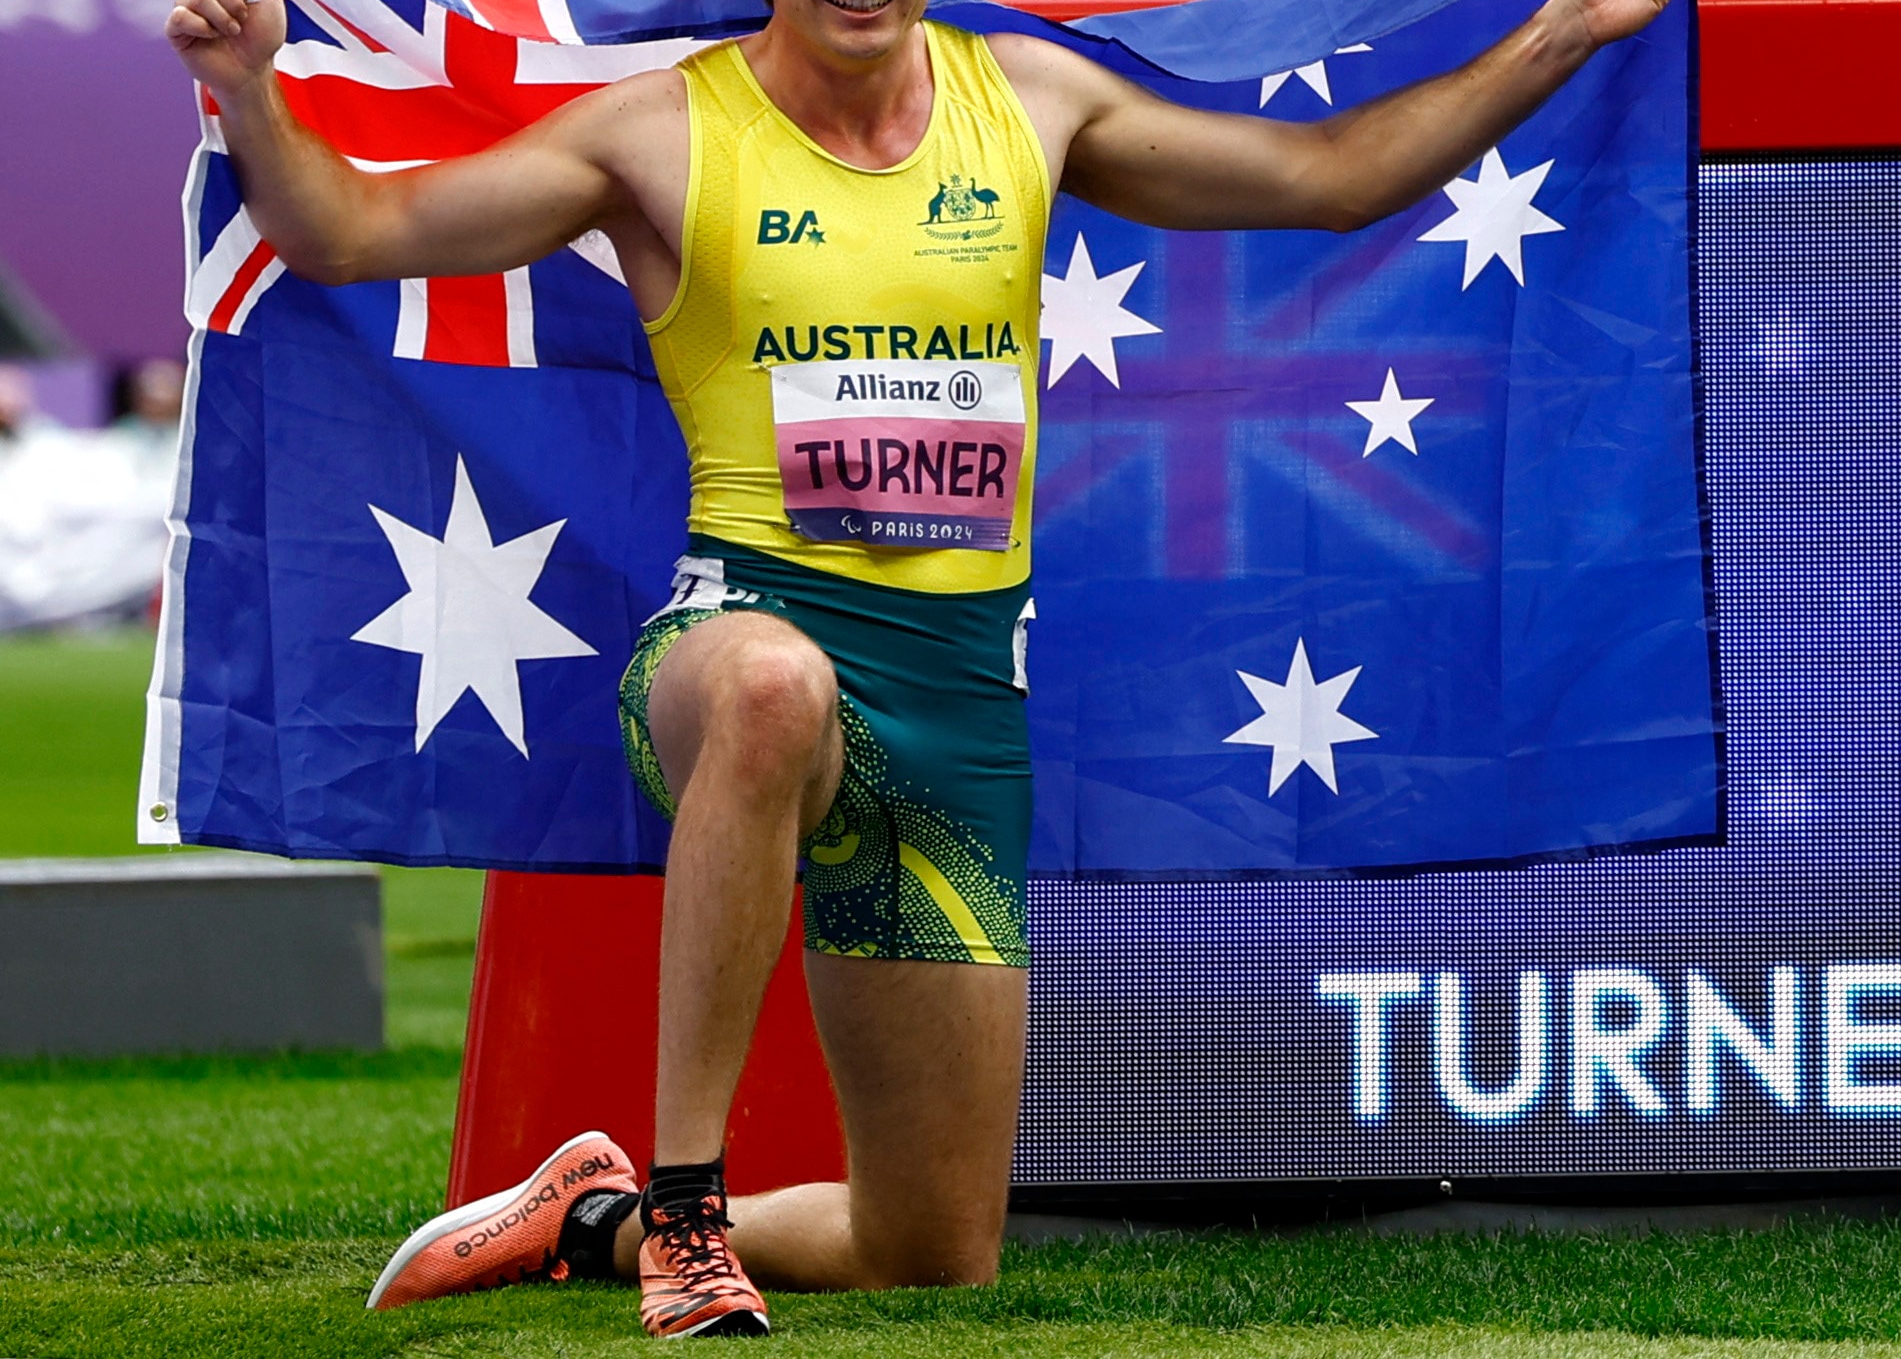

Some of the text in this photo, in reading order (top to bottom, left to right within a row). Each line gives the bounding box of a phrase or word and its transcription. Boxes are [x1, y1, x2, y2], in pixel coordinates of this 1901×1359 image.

[950, 255, 972, 263] PARIS
[1002, 244, 1018, 252] TEAM
[752, 321, 1020, 362] AUSTRALIA
[835, 373, 942, 402] Allianz
[794, 438, 1008, 499] TURNER
[871, 520, 974, 541] PARIS 2024
[454, 1152, 615, 1258] new balance
